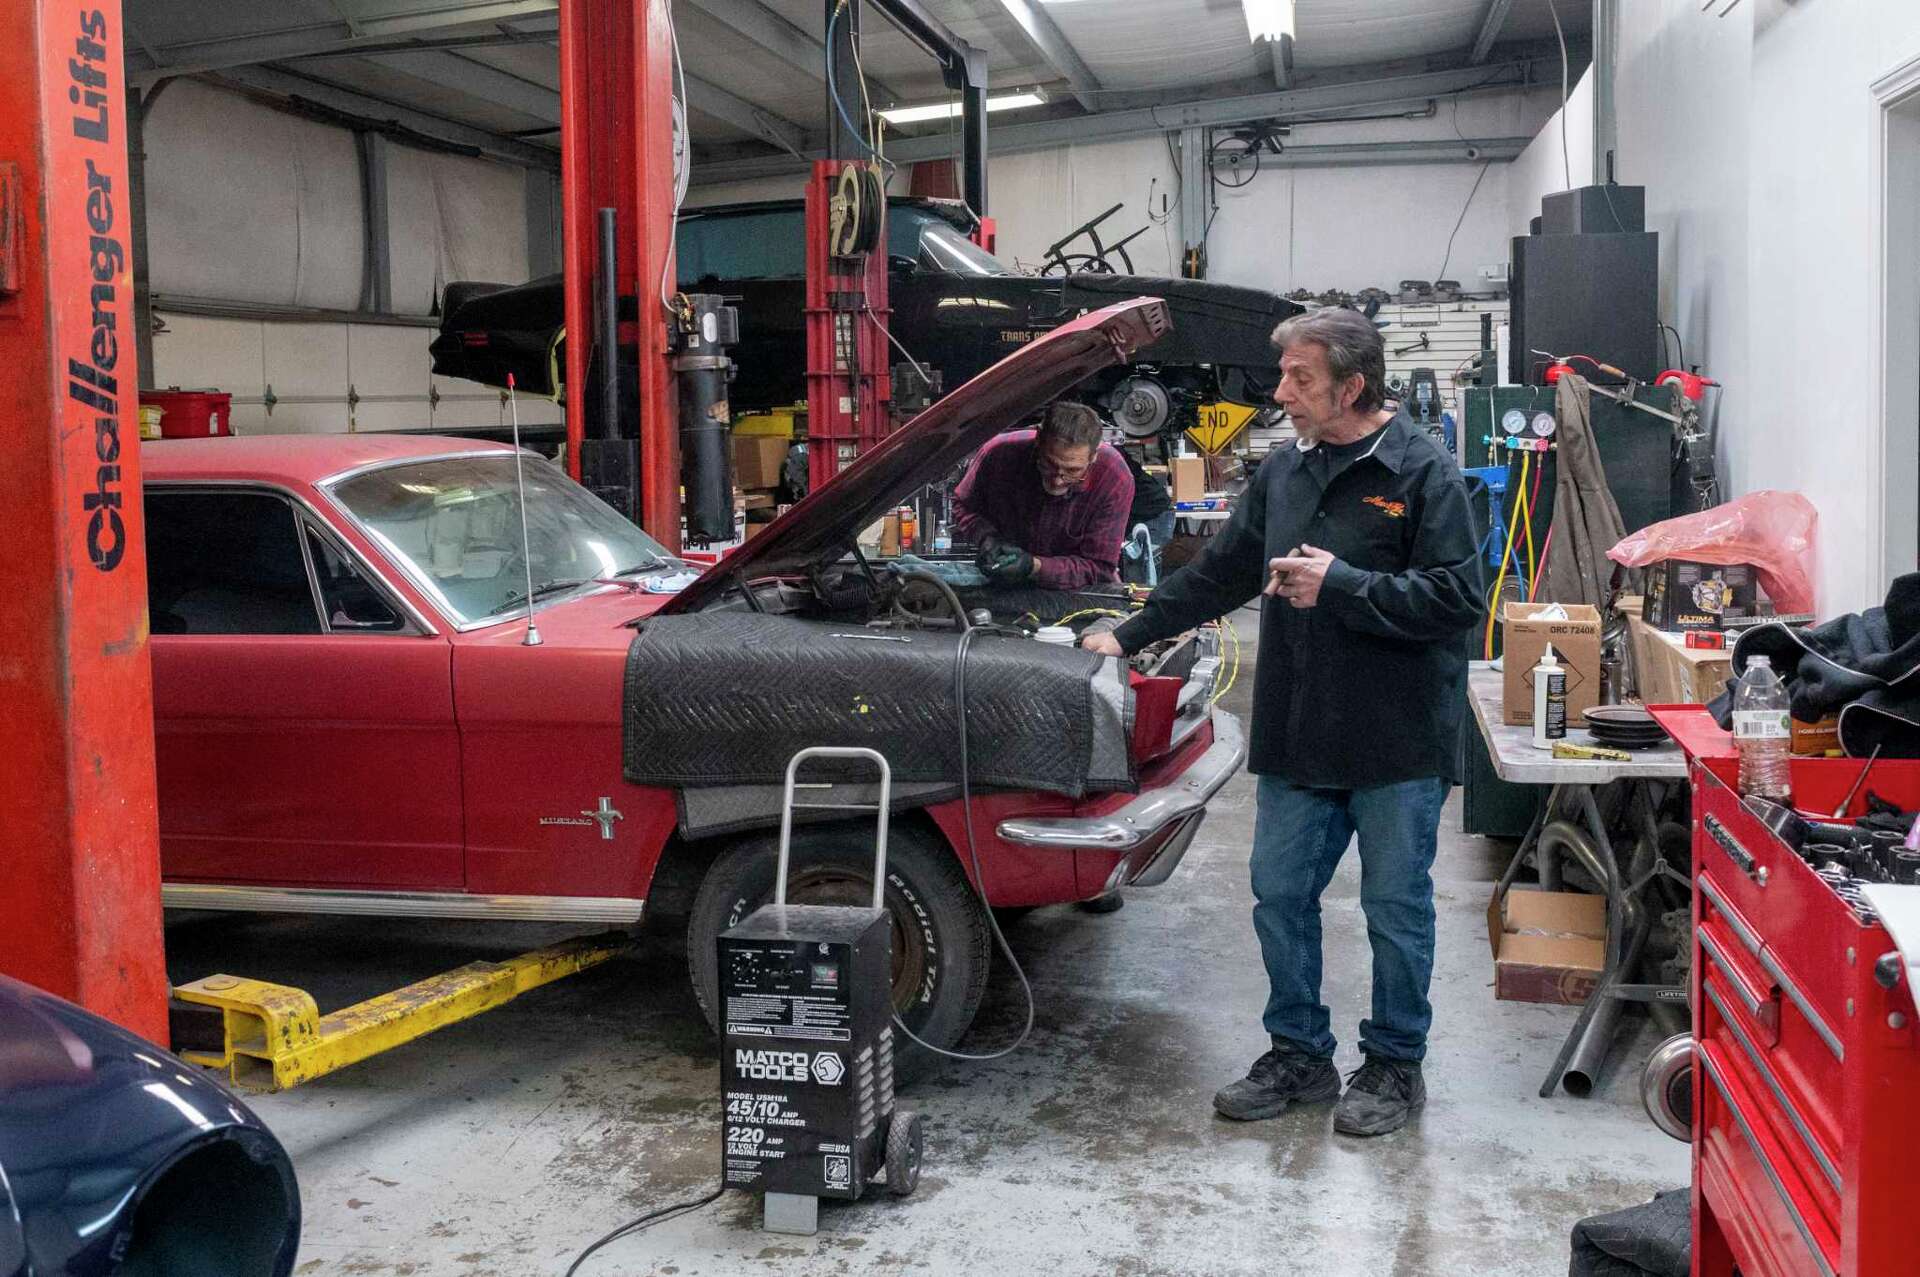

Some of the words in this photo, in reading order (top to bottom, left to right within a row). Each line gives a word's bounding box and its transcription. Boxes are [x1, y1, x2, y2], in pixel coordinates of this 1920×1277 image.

[69, 9, 109, 144] Lifts
[1000, 331, 1032, 342] TRANS
[68, 159, 126, 572] Challenger
[1677, 614, 1716, 624] ULTIMA
[736, 1049, 808, 1067] MATCO
[736, 1063, 808, 1081] TOOLS
[727, 1092, 755, 1100] MODEL
[727, 1100, 780, 1117] 45/10
[745, 1116, 766, 1124] VOLT
[767, 1117, 806, 1127] CHARGER
[727, 1126, 765, 1143] 220
[759, 1151, 786, 1159] START
[835, 1144, 851, 1154] USA
